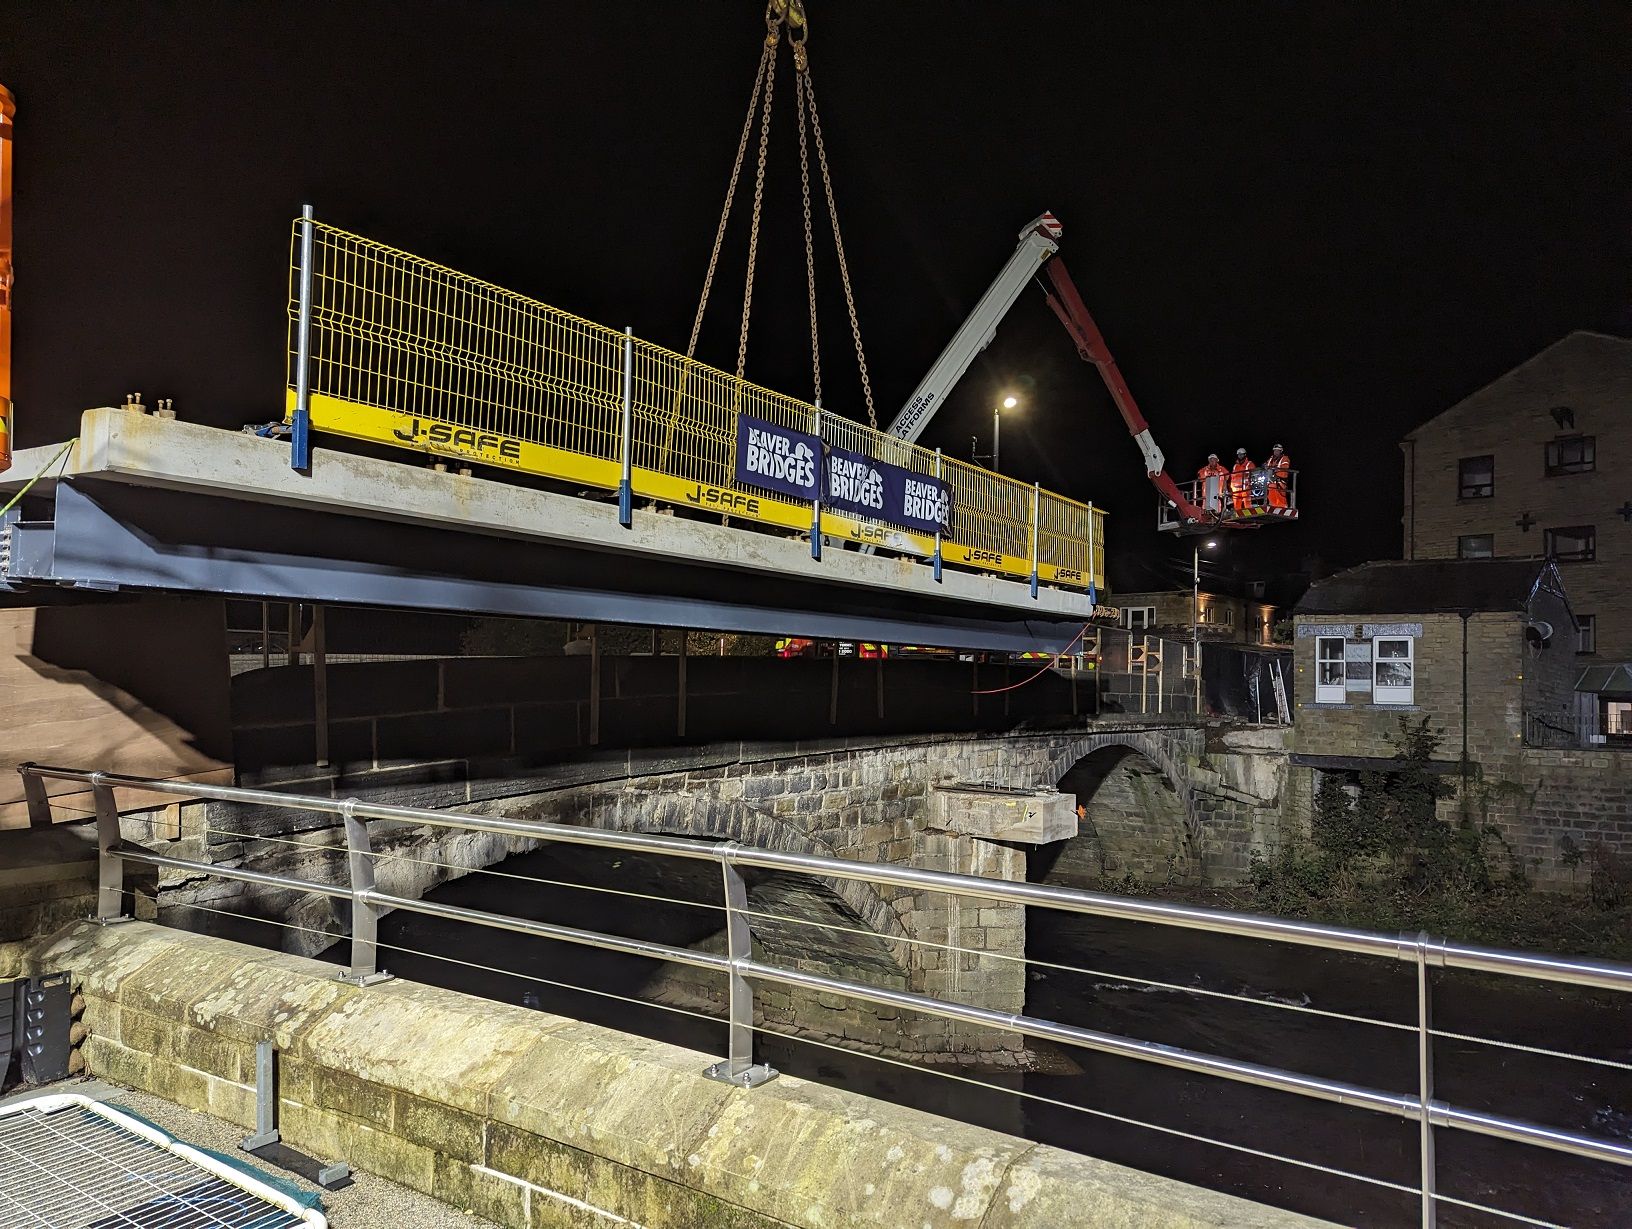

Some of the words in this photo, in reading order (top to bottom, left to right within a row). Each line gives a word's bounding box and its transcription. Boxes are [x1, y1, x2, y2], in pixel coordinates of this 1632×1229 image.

[894, 392, 935, 446] LATFORMS
[895, 396, 923, 434] ACCESS
[748, 426, 791, 457] BEAVER
[746, 444, 815, 488] BRIDGES
[831, 472, 884, 510] BRIDGES
[904, 478, 939, 502] BEAVER
